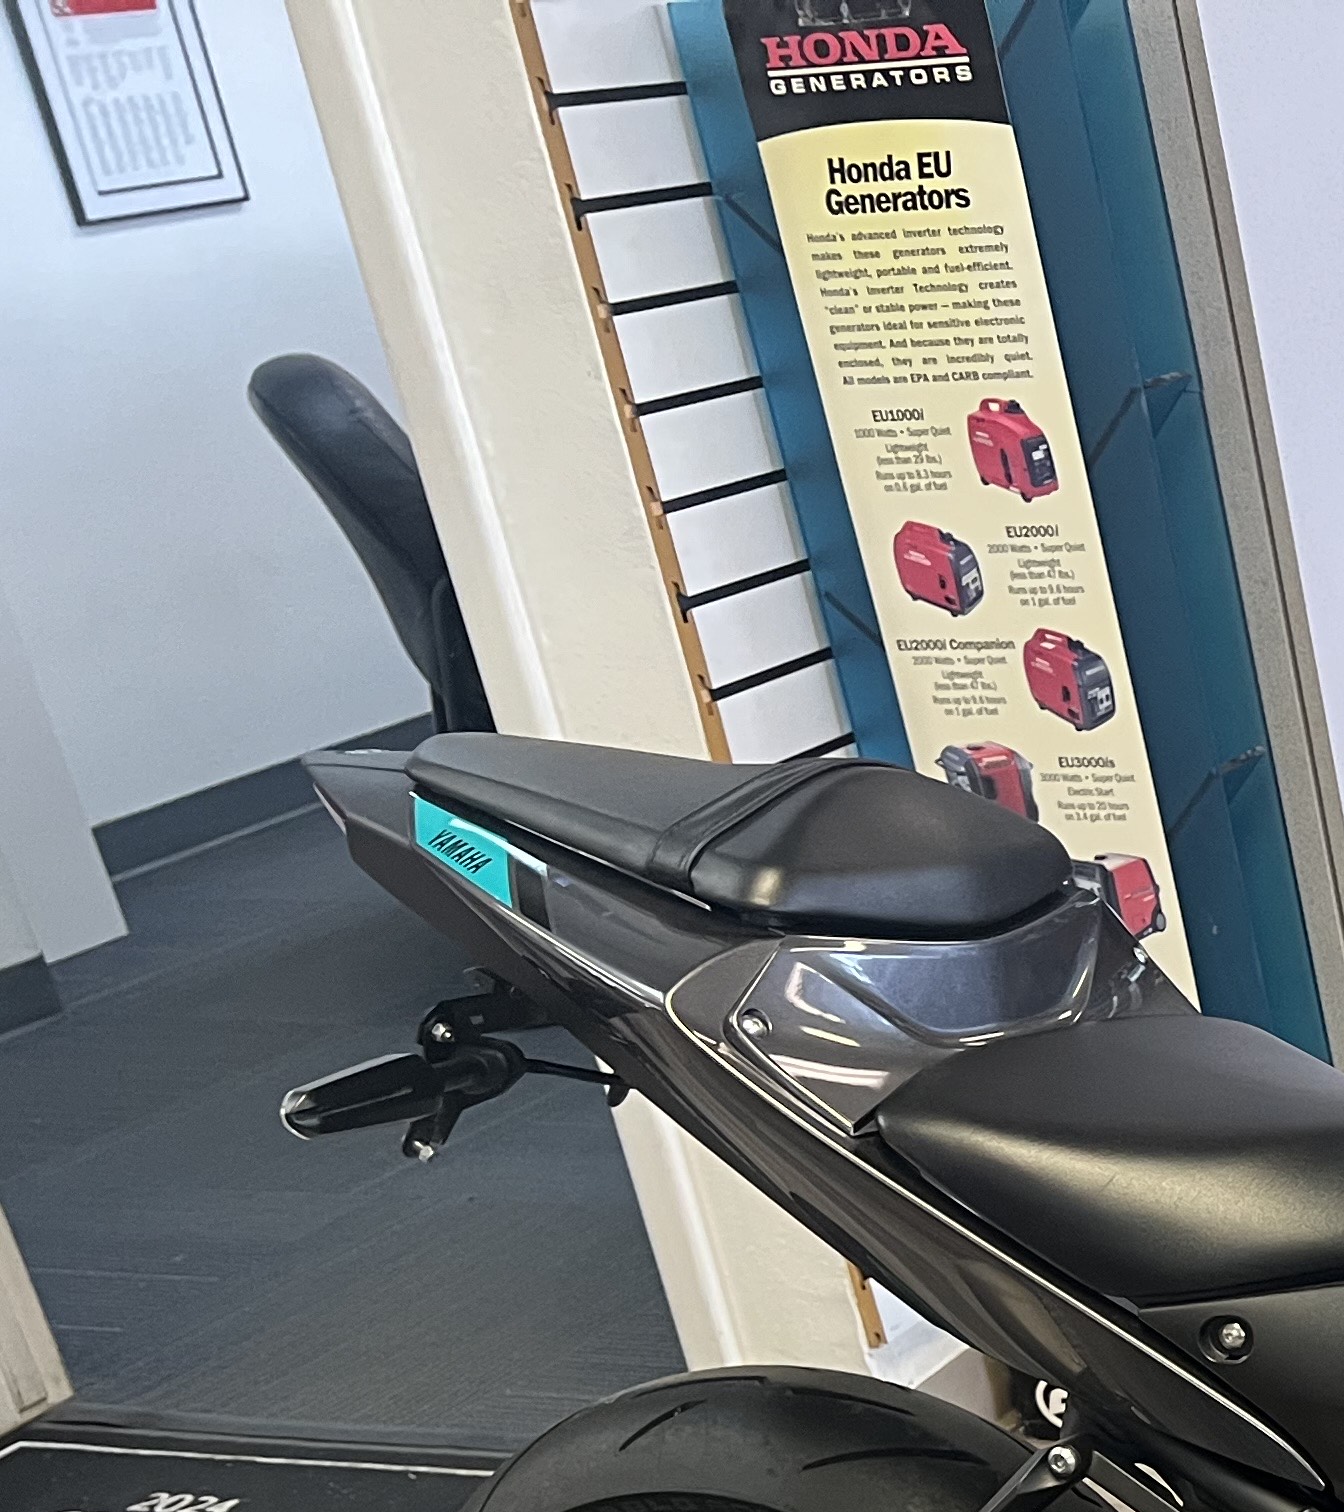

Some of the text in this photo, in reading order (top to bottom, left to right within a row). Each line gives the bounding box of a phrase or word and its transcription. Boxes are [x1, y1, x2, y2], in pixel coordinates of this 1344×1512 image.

[760, 22, 968, 69] HONDA
[769, 65, 974, 96] GENERATORS
[826, 150, 952, 185] Honda EU
[825, 184, 971, 216] Generators
[947, 224, 1004, 236] technology
[892, 247, 946, 260] generators
[958, 242, 1009, 254] extremely
[876, 265, 917, 278] portable
[921, 264, 940, 275] and
[944, 260, 1013, 273] fuel-efficient.
[979, 279, 1017, 290] creates
[862, 305, 872, 313] or
[908, 302, 937, 313] power
[952, 298, 990, 310] making
[992, 298, 1021, 307] these
[909, 319, 924, 329] for
[927, 318, 971, 329] sensitive
[974, 314, 1025, 326] electronic
[953, 336, 974, 347] they
[996, 333, 1029, 345] totally
[891, 357, 912, 367] they
[910, 373, 930, 383] EPA
[932, 372, 950, 382] and
[951, 370, 980, 381] CARB
[871, 408, 925, 422] EU1000i
[1005, 524, 1059, 538] EU2000i
[949, 637, 1016, 653] Companion
[427, 829, 492, 875] YAMAHA
